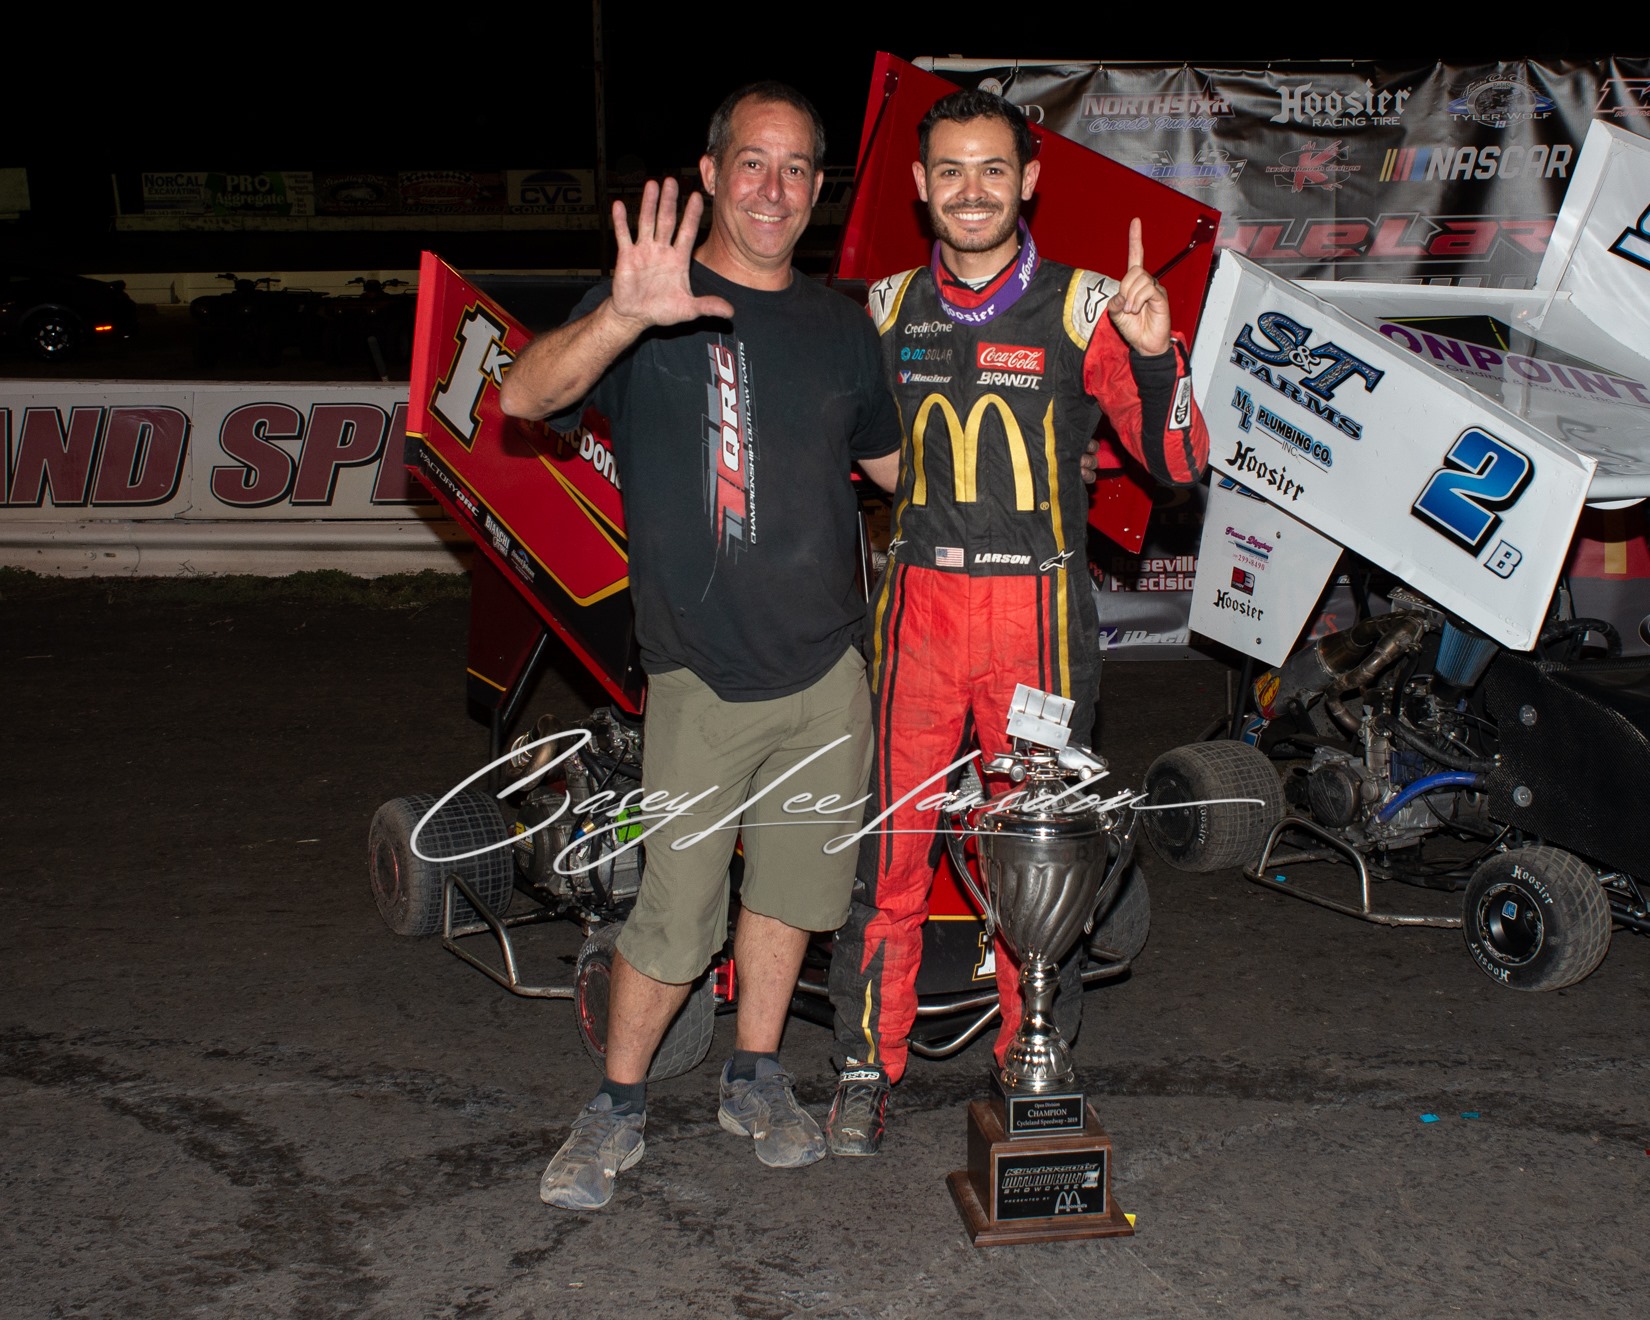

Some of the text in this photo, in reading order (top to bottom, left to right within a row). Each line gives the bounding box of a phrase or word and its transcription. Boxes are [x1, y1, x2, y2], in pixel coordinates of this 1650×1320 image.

[1270, 79, 1411, 124] Hoosier
[1089, 115, 1217, 134] Concrete Pumping
[1312, 116, 1400, 127] RACING TIRE
[1450, 111, 1552, 121] TYLER WOLF
[1425, 144, 1573, 181] NASCAR
[226, 174, 271, 192] PRO
[520, 186, 583, 204] CVC
[216, 192, 286, 207] Aggregate
[911, 348, 953, 364] DC SOLAR
[980, 346, 1043, 370] Coca-Cola
[1379, 323, 1650, 405] ONPOINT
[976, 371, 1043, 389] BRANDT
[1229, 346, 1364, 441] FARMS
[1255, 405, 1313, 454] PLUMBING
[738, 340, 758, 544] CHAMPIONSHIP OUTLAW KARTS
[0, 406, 191, 508] ND
[1225, 440, 1305, 501] Hoosier
[974, 553, 1032, 566] LARSON
[1213, 588, 1264, 622] Hoosier
[1510, 864, 1554, 905] Hoosier
[1471, 942, 1511, 982] Hoosier
[1027, 1108, 1068, 1119] CHAMPION
[1003, 1184, 1080, 1195] SHOWCASE
